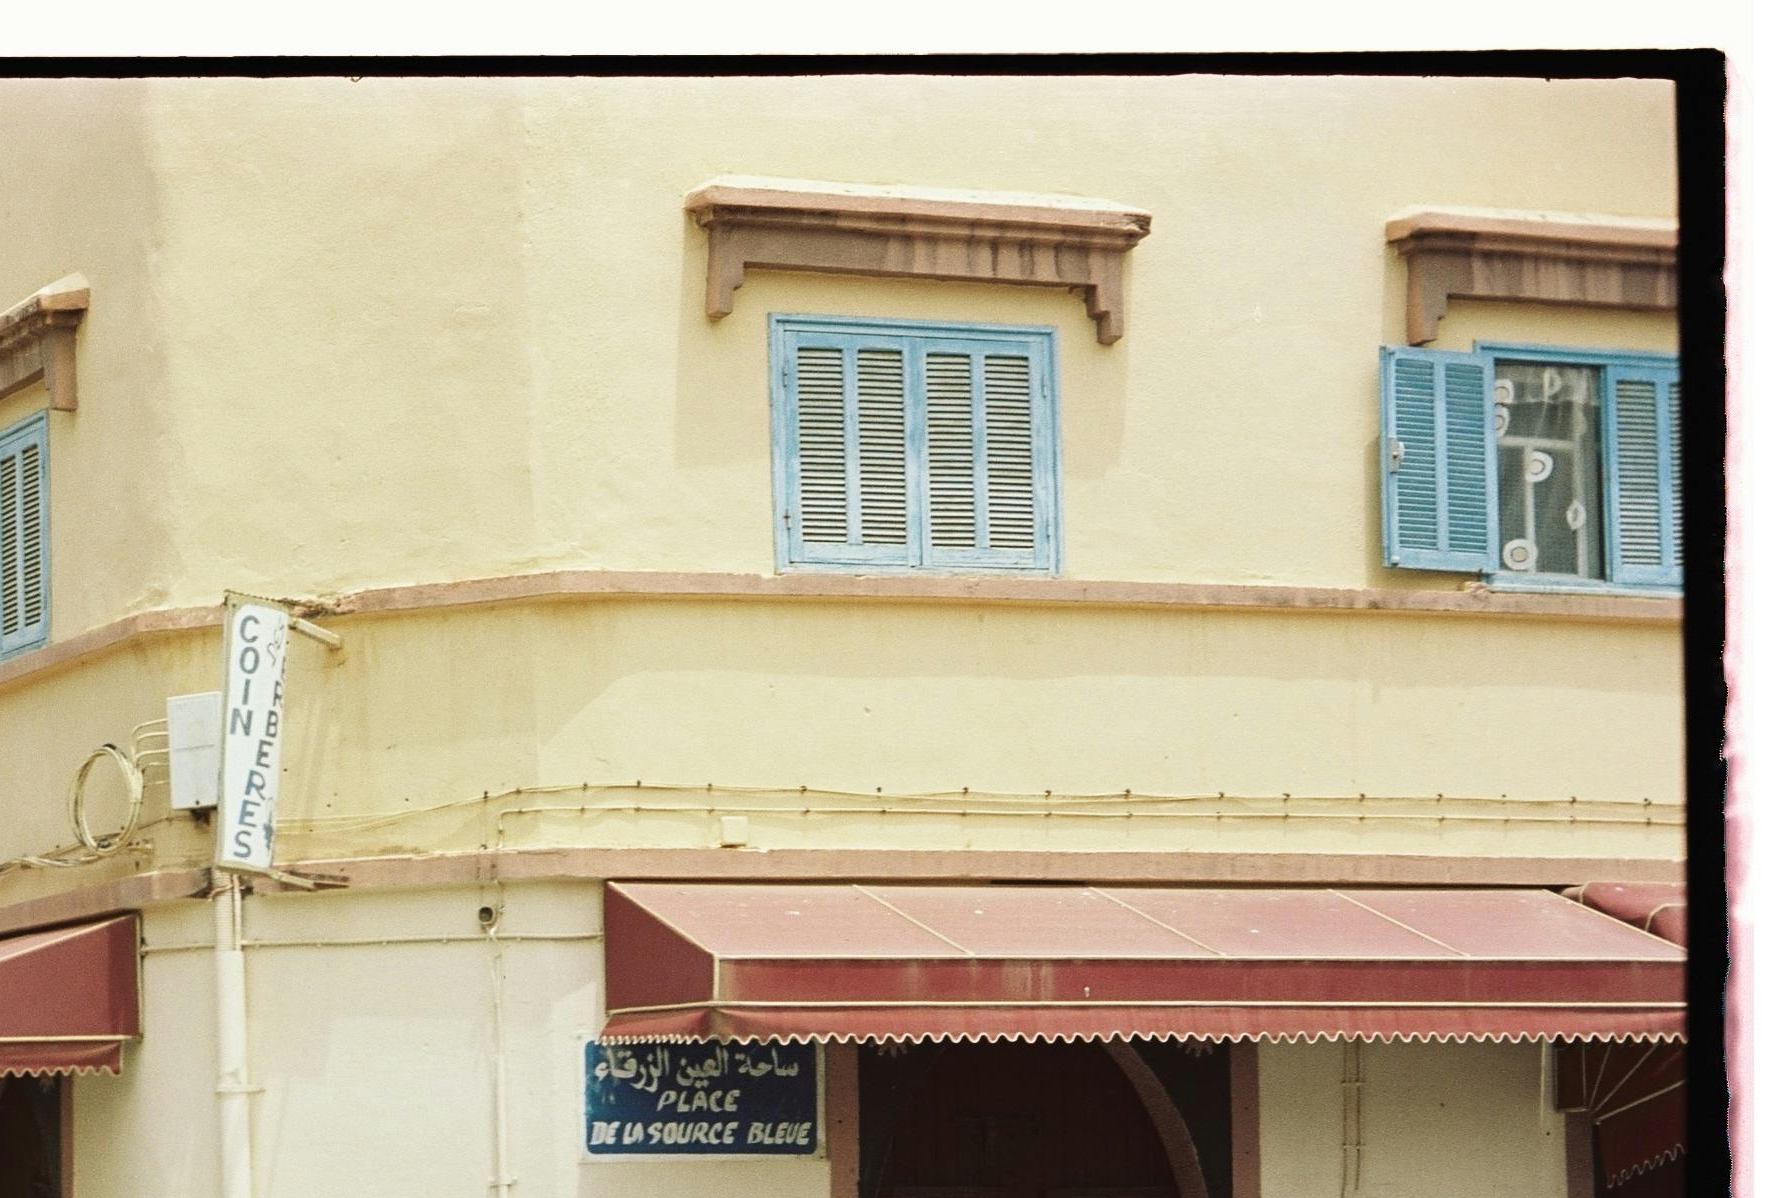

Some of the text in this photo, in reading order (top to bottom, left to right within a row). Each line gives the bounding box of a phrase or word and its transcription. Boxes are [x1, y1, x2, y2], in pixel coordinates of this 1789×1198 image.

[229, 614, 260, 736] COIN
[594, 1045, 799, 1093] ساحة العين الزرقاء
[657, 1089, 741, 1113] PLACE
[590, 1121, 812, 1145] DE LA SOURCE BLEUE
